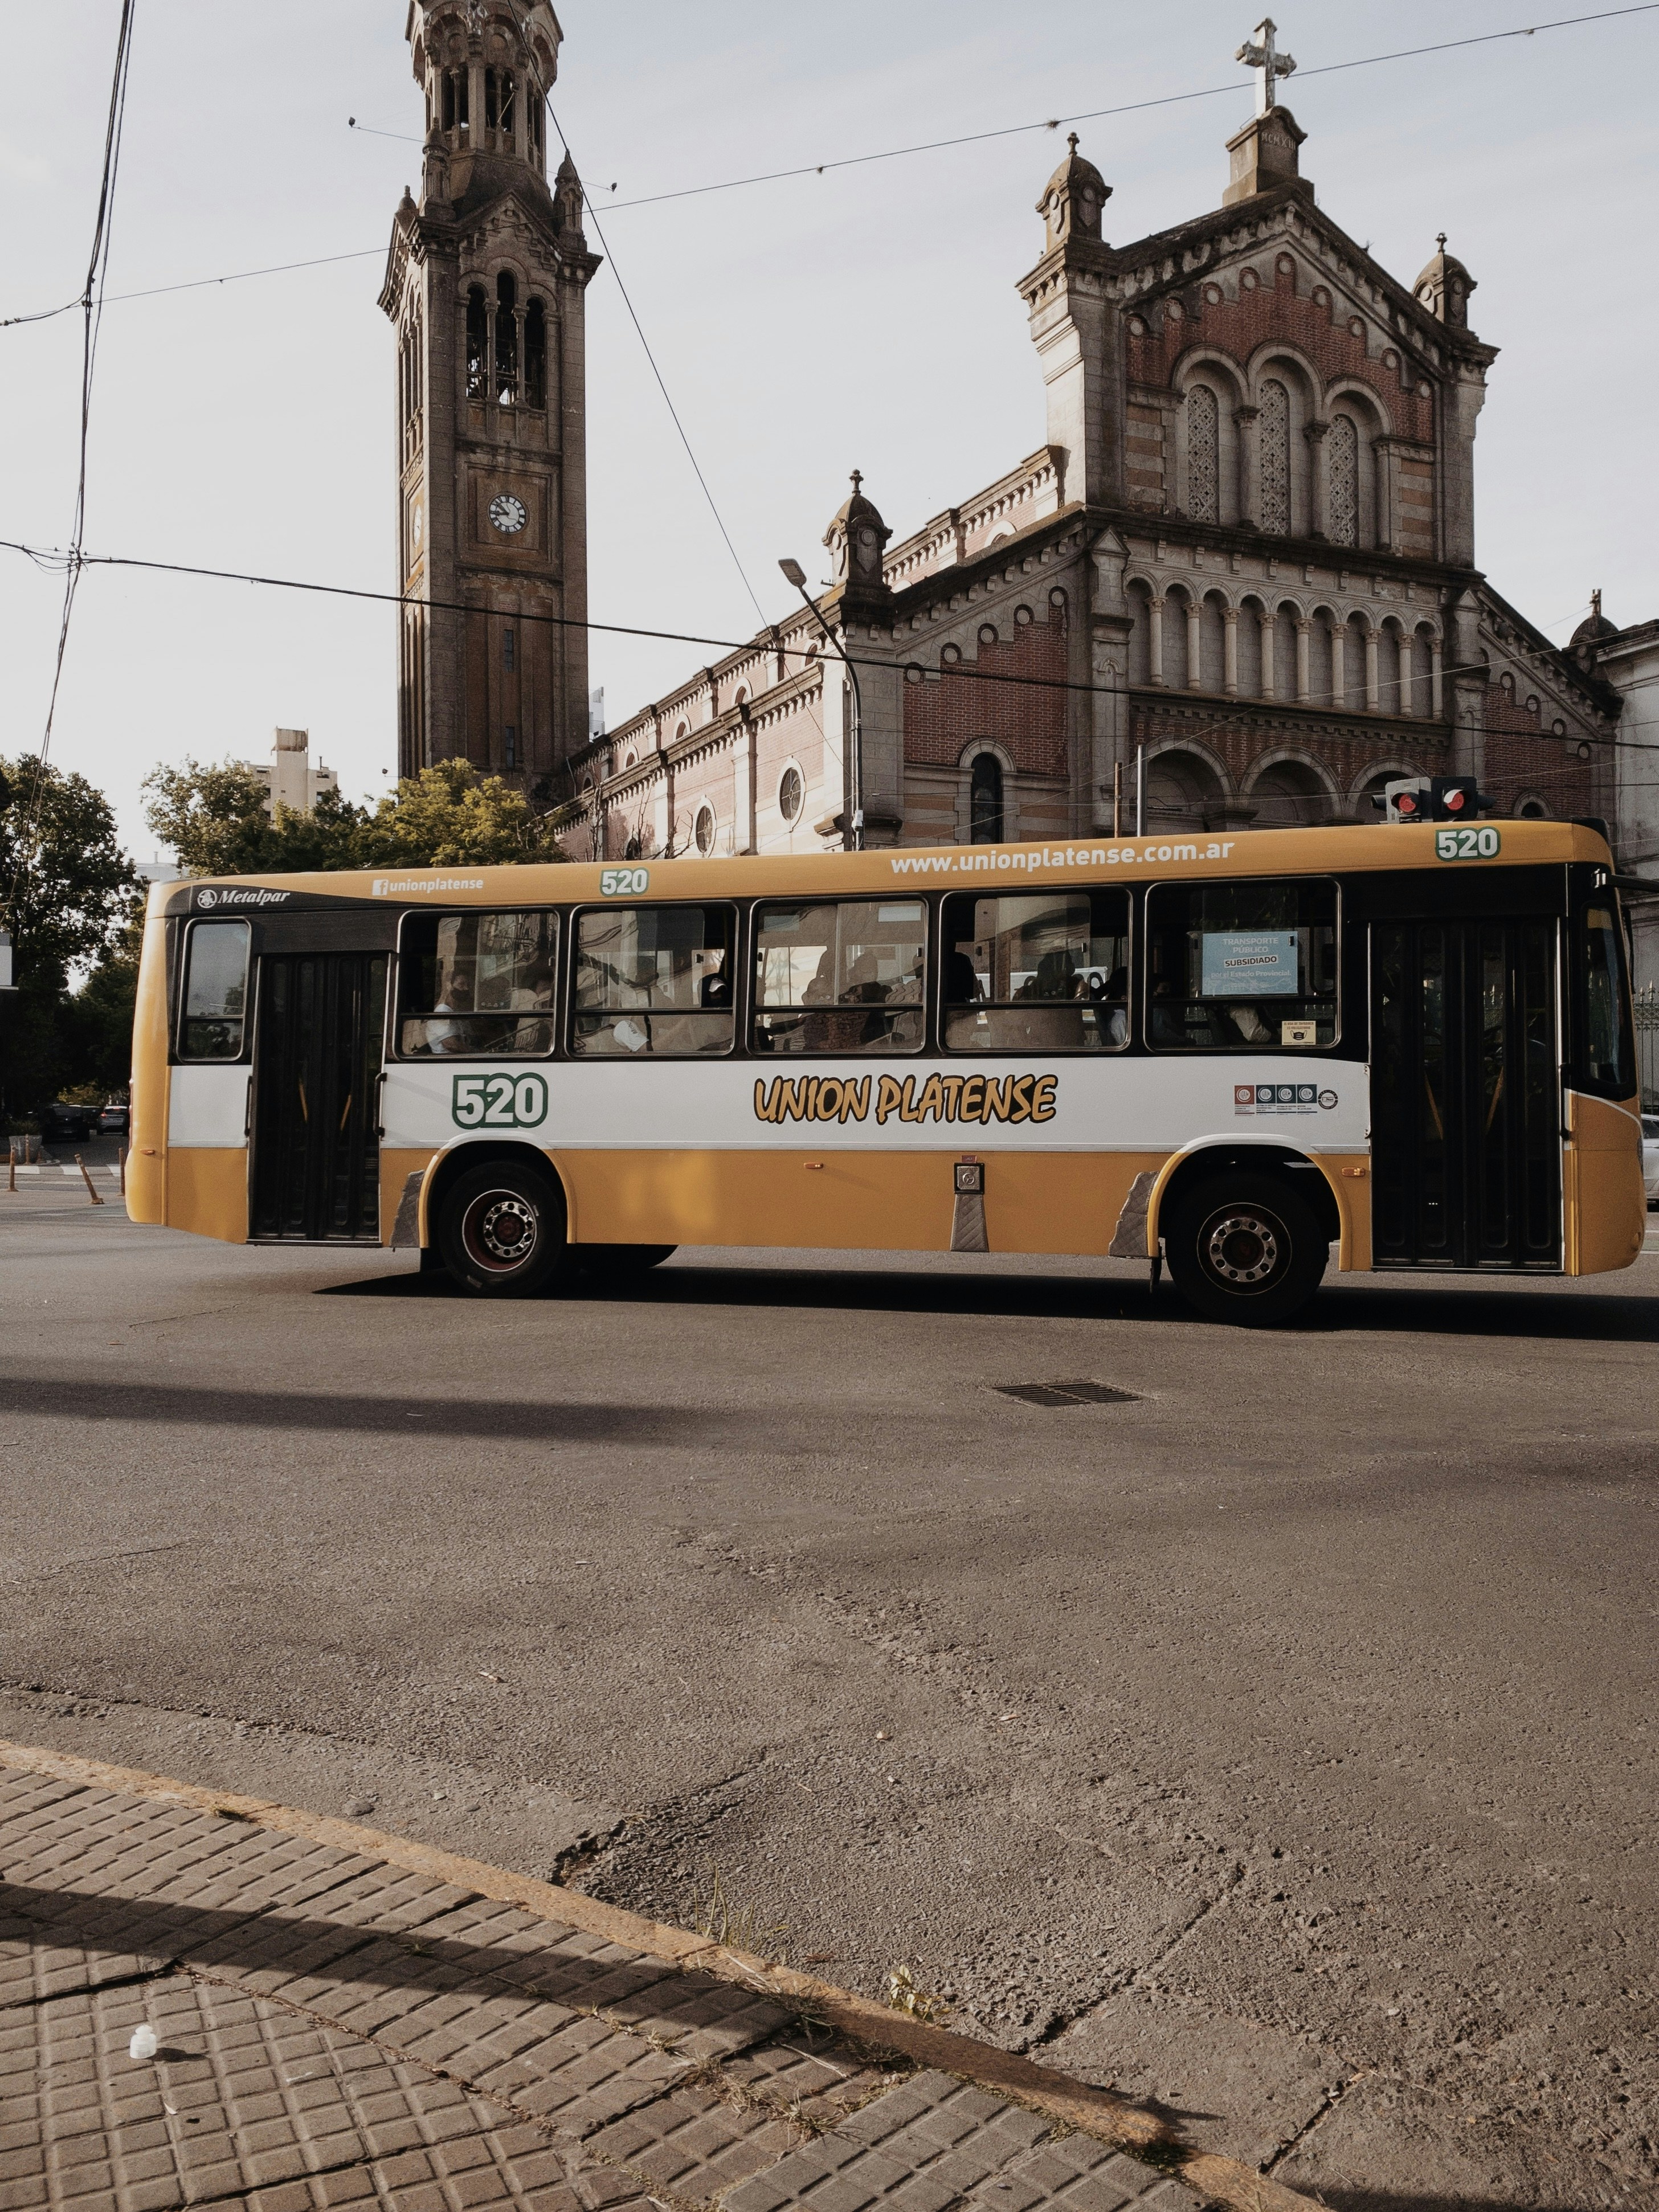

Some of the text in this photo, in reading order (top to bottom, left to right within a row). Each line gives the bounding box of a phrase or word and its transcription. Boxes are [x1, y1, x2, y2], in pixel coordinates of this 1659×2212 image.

[891, 843, 1235, 873] www.unionplatense.com.ar
[1437, 827, 1499, 860] 520
[390, 877, 484, 893] unionplatense
[600, 868, 648, 896] 520
[217, 889, 291, 906] Metalpar
[1225, 956, 1277, 967] SUBSIDIADO
[453, 1073, 547, 1128] 520
[754, 1072, 1059, 1125] UNION PLATENSE
